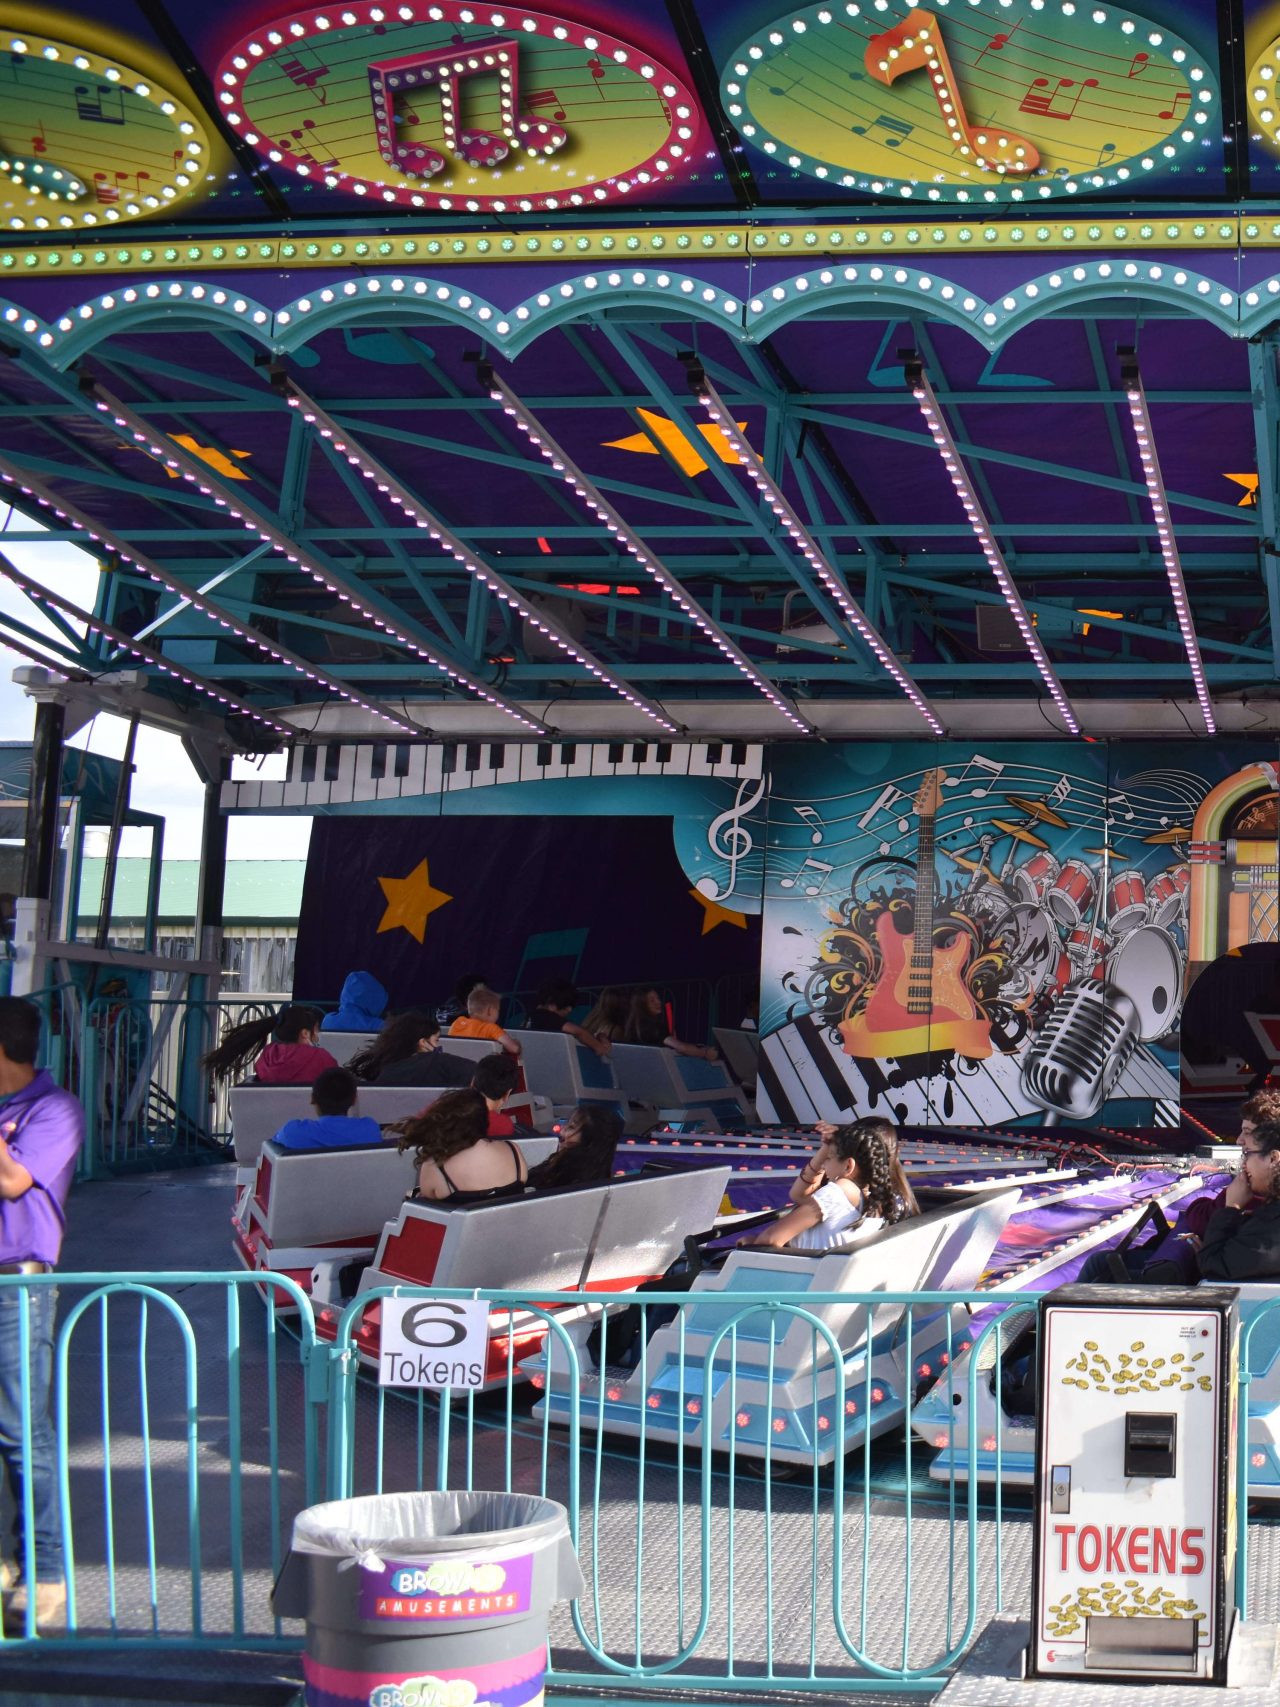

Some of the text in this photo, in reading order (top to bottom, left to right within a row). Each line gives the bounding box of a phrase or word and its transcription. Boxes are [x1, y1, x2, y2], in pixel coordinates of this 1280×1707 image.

[401, 1301, 468, 1348] 6
[384, 1352, 482, 1386] Tokens
[1052, 1523, 1206, 1576] TOKENS
[379, 1595, 514, 1613] AMUSEMENTS
